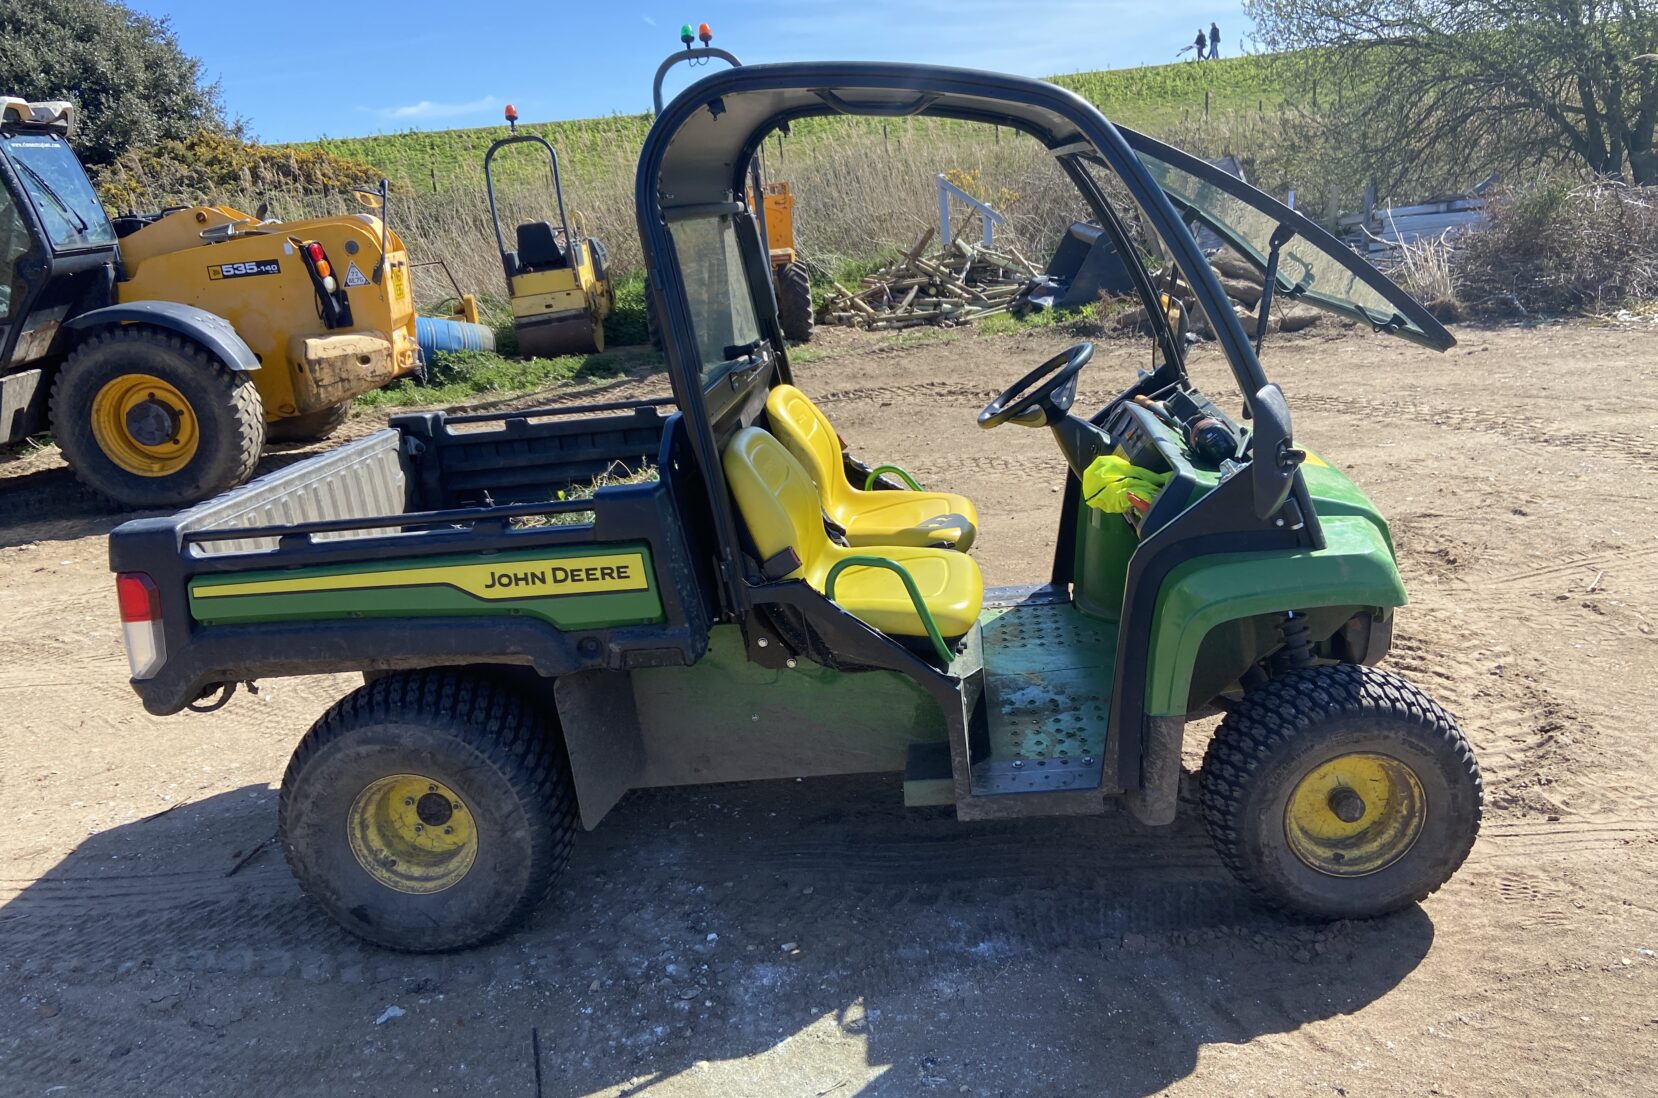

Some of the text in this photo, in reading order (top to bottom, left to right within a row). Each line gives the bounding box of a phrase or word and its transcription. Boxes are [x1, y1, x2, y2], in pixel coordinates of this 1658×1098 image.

[222, 262, 277, 276] 535-140
[485, 565, 630, 588] JOHN DEERE
